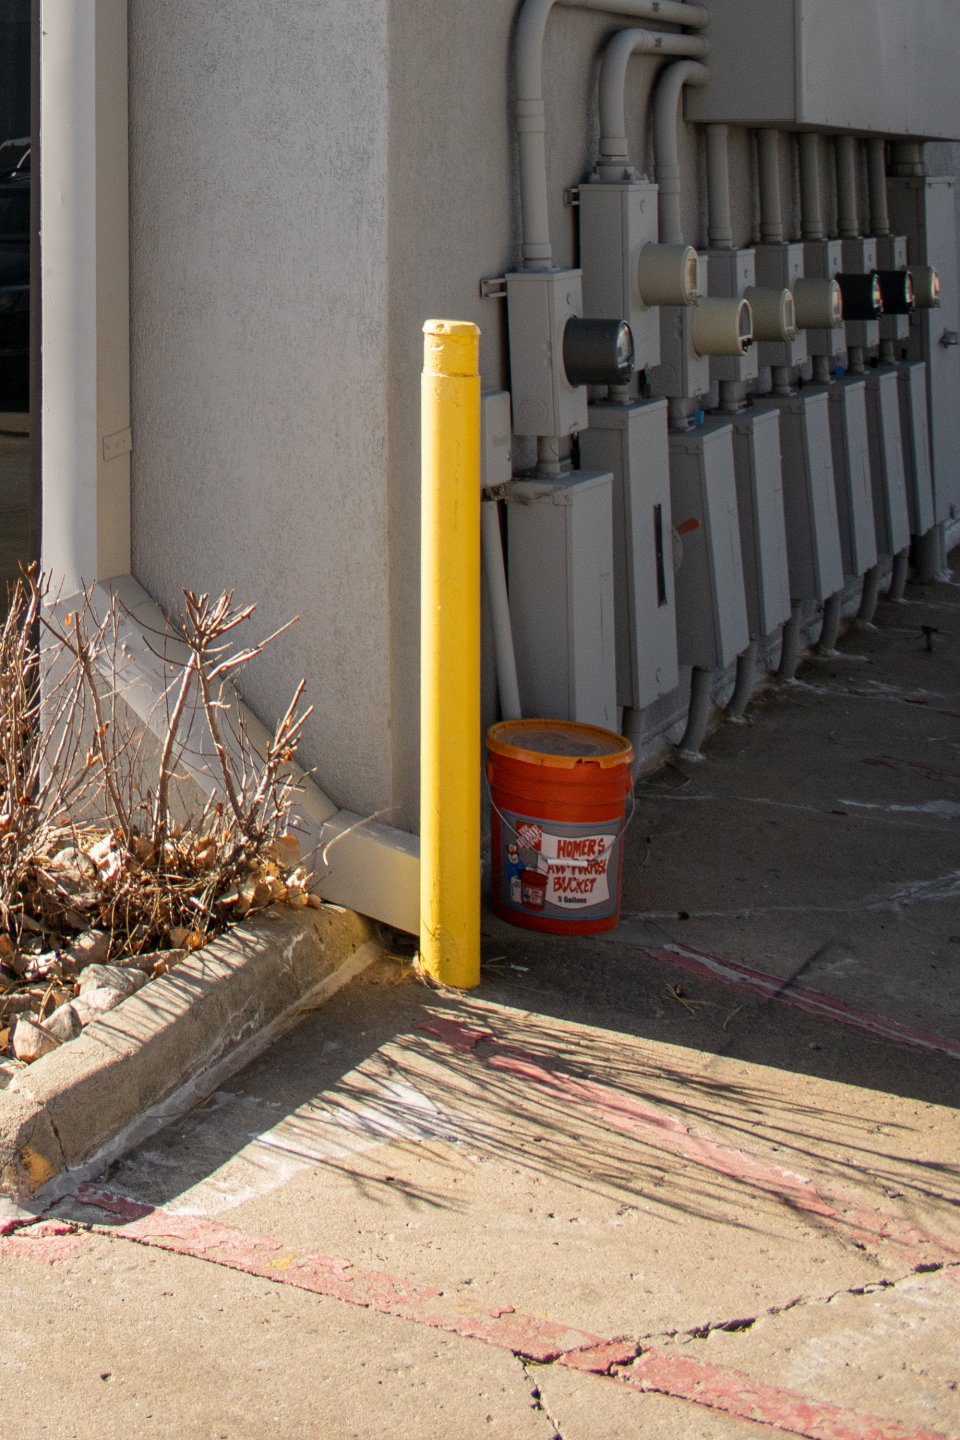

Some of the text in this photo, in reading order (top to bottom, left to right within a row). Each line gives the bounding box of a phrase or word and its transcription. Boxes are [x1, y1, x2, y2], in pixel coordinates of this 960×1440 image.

[557, 837, 606, 858] HOMER'S
[553, 876, 597, 894] BUCKET
[557, 895, 587, 904] 5 Gallons
